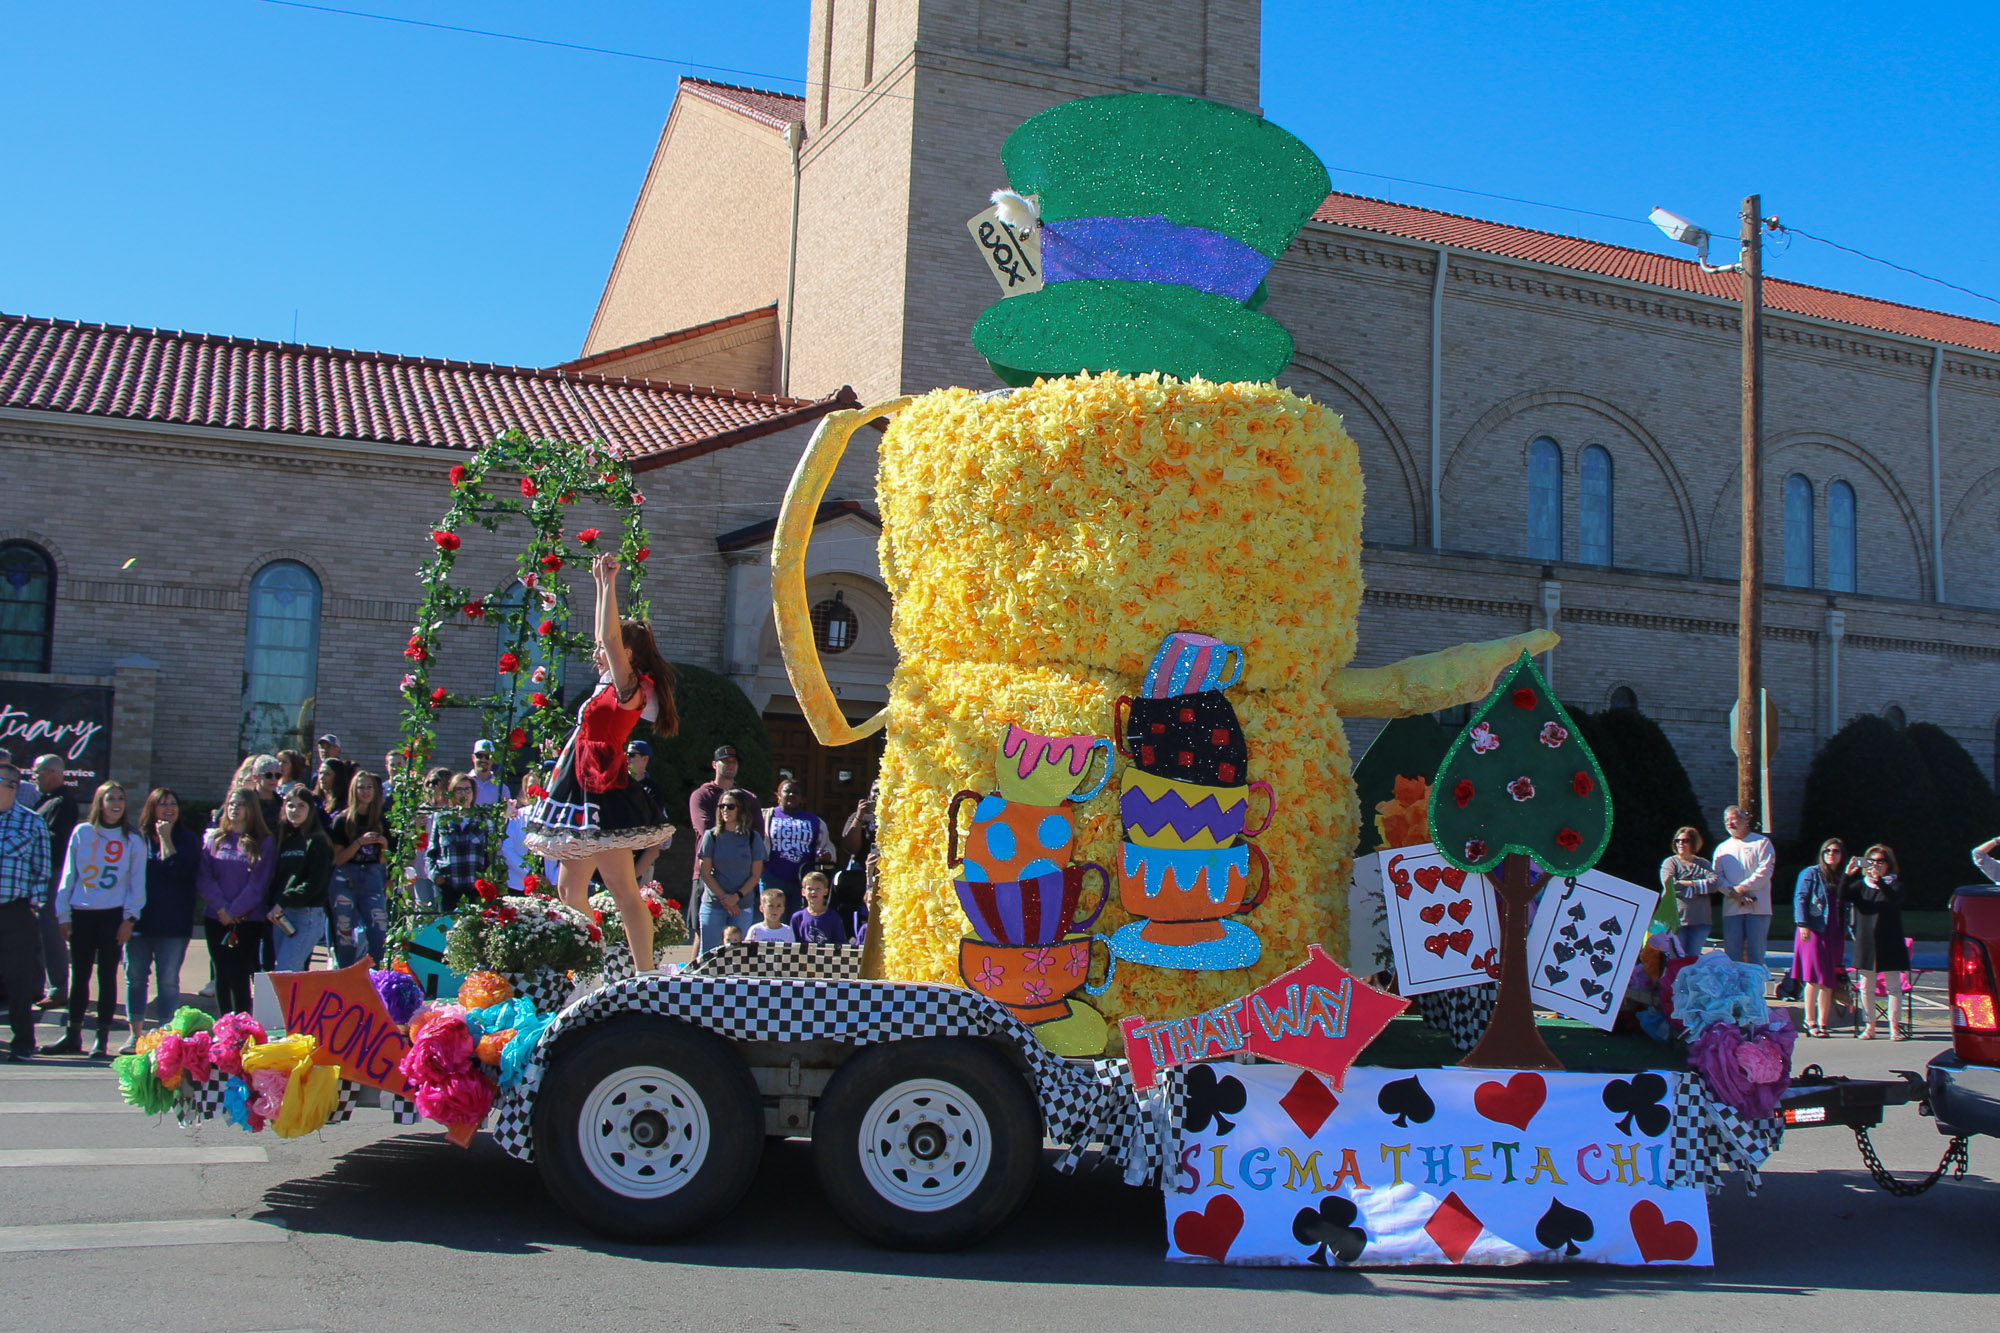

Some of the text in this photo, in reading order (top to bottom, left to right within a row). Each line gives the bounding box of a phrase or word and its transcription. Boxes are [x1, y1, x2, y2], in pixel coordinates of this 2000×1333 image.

[769, 827, 813, 842] FIGHT!
[771, 838, 811, 853] FIGHT!
[88, 839, 124, 864] 19
[81, 864, 119, 890] 25
[1388, 853, 1410, 885] 6
[1560, 876, 1577, 900] 9
[287, 981, 405, 1085] WRONG
[1131, 977, 1353, 1067] THAT WAY
[1177, 1141, 1674, 1194] SIGMA THETA CHI
